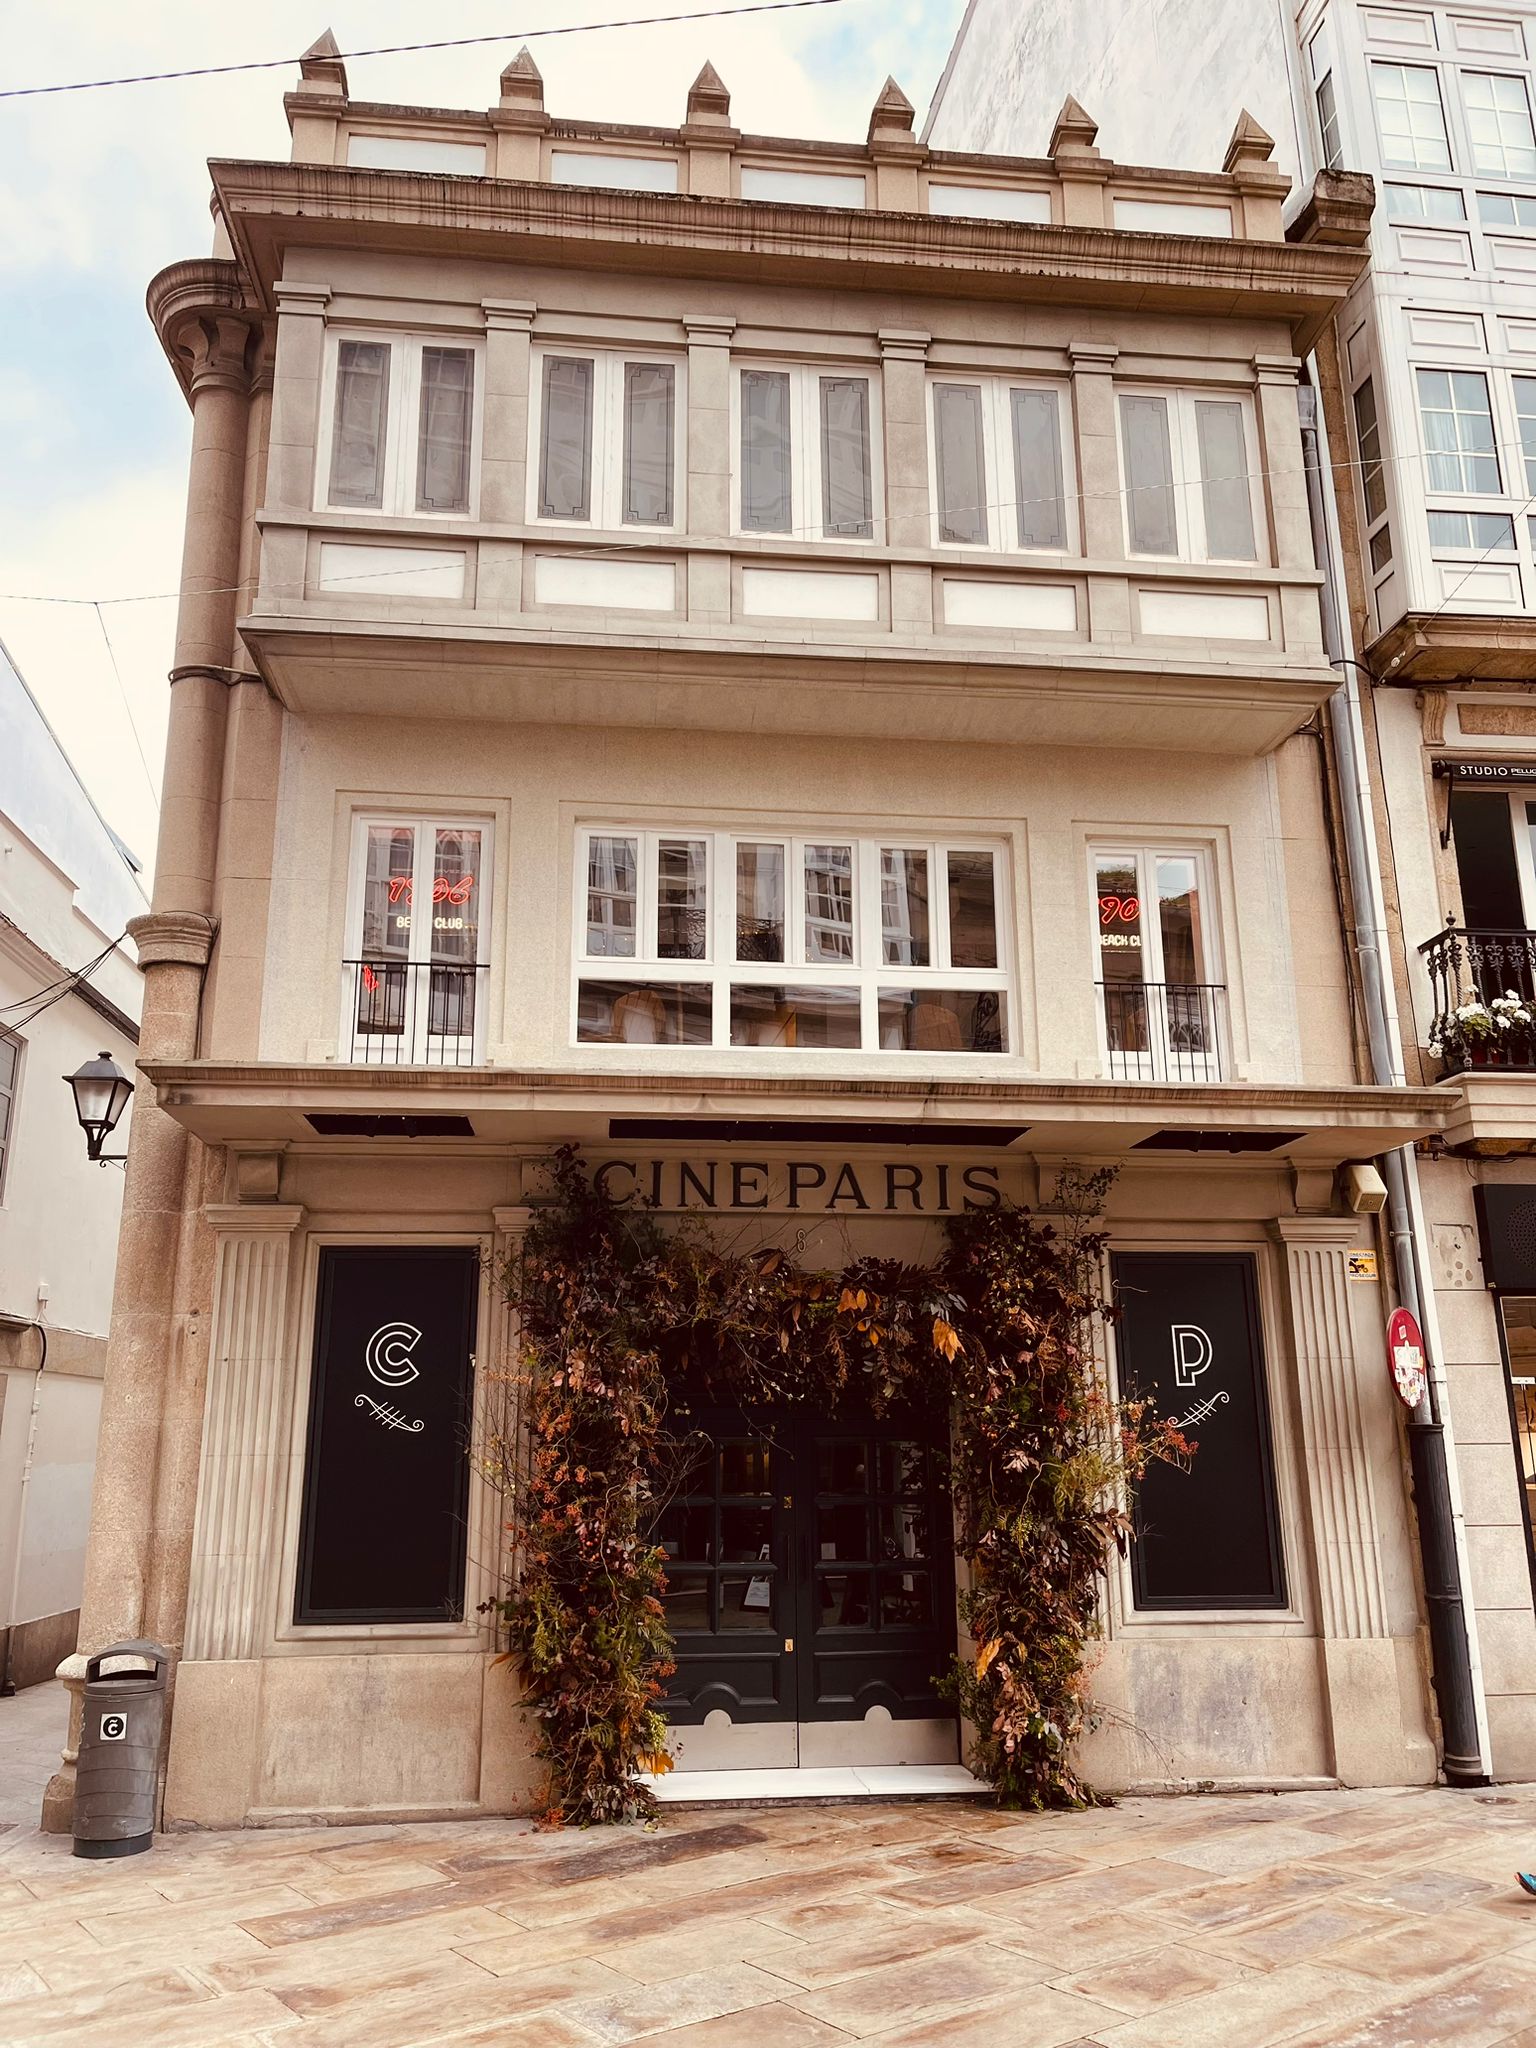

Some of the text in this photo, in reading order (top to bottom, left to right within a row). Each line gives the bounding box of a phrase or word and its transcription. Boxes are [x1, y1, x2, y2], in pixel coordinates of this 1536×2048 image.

[1460, 765, 1508, 776] STUDIO
[366, 1322, 422, 1386] C
[1171, 1324, 1213, 1386] P
